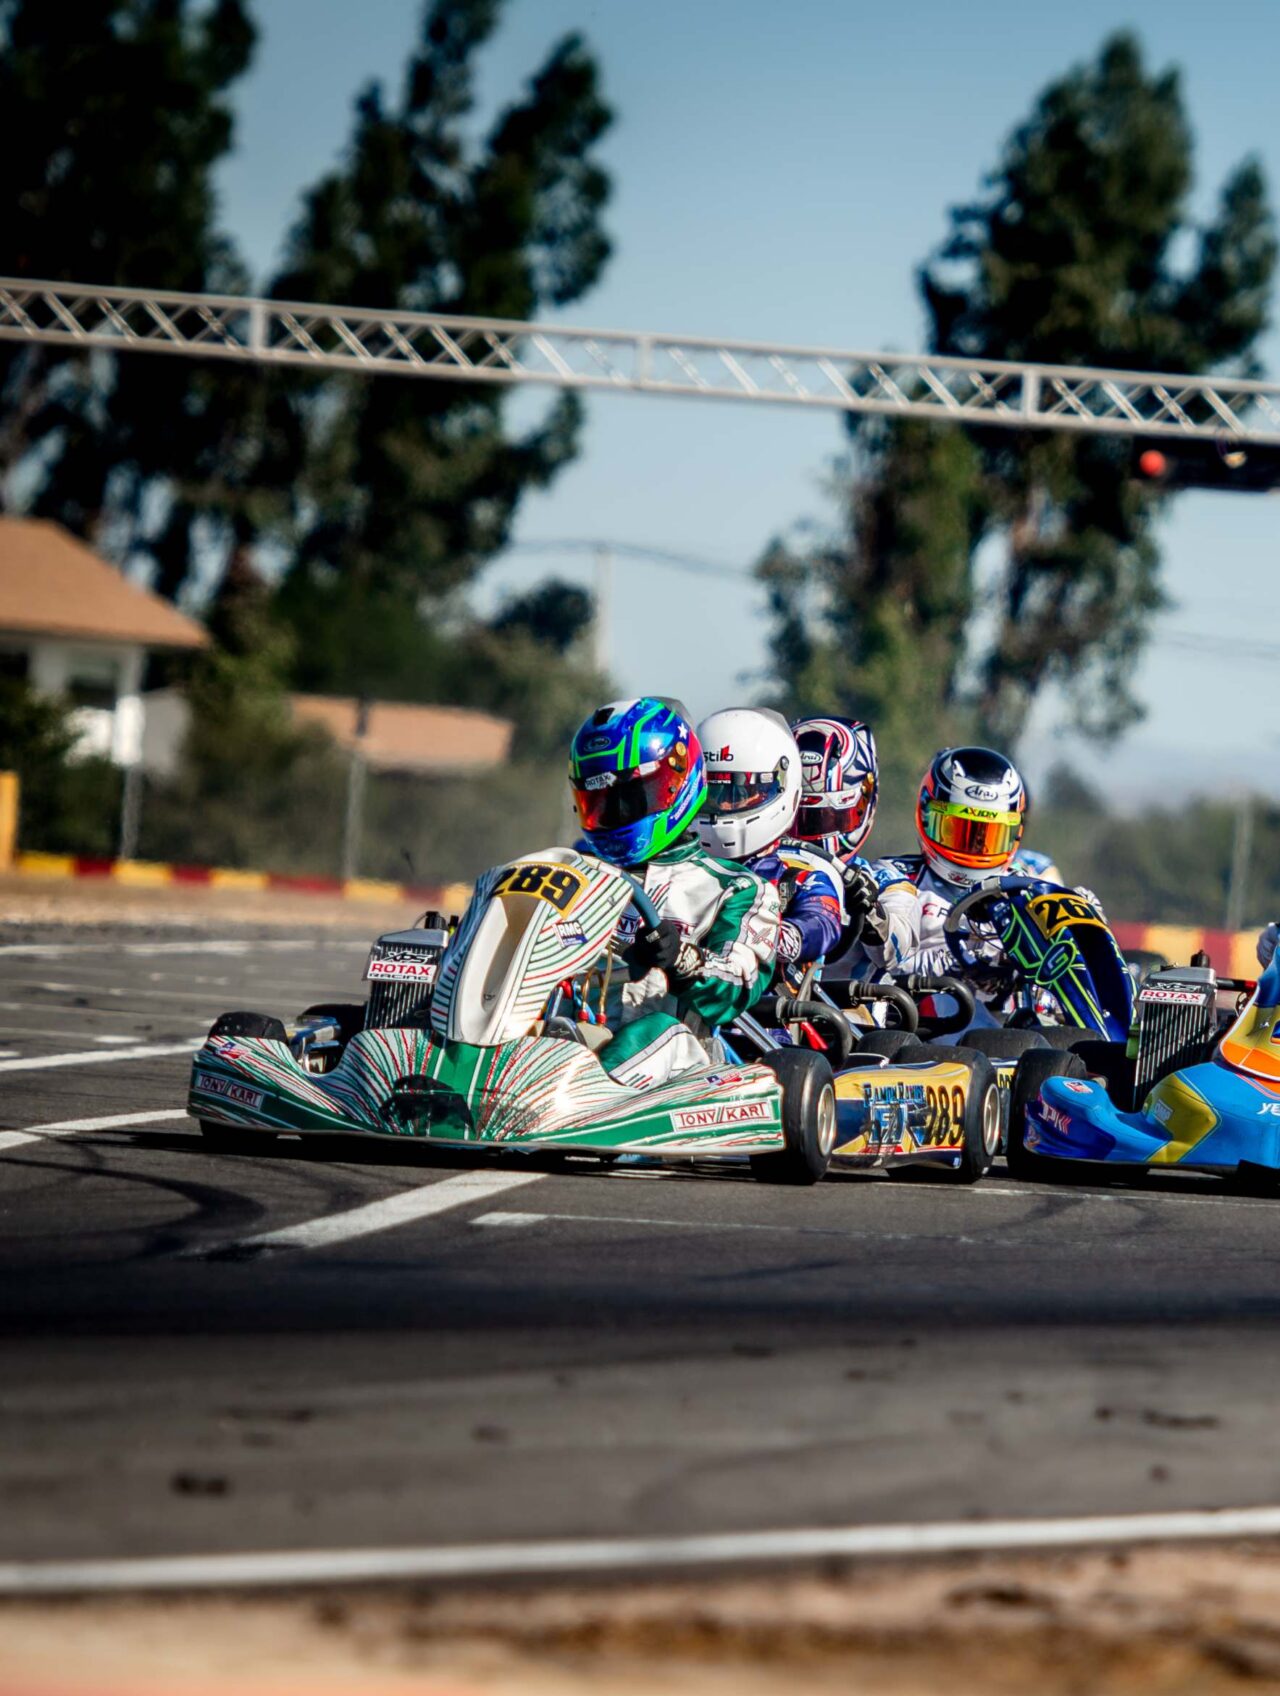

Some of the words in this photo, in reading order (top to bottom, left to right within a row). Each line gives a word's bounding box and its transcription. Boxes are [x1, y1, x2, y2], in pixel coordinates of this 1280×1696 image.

[704, 745, 733, 762] Stilo
[960, 808, 998, 818] AXION
[492, 865, 580, 911] 289
[371, 963, 431, 976] ROTAX
[1142, 991, 1201, 1000] ROTAX
[201, 1074, 225, 1092] TONY
[229, 1083, 260, 1105] KART
[676, 1110, 716, 1126] TONY
[725, 1101, 767, 1119] KART
